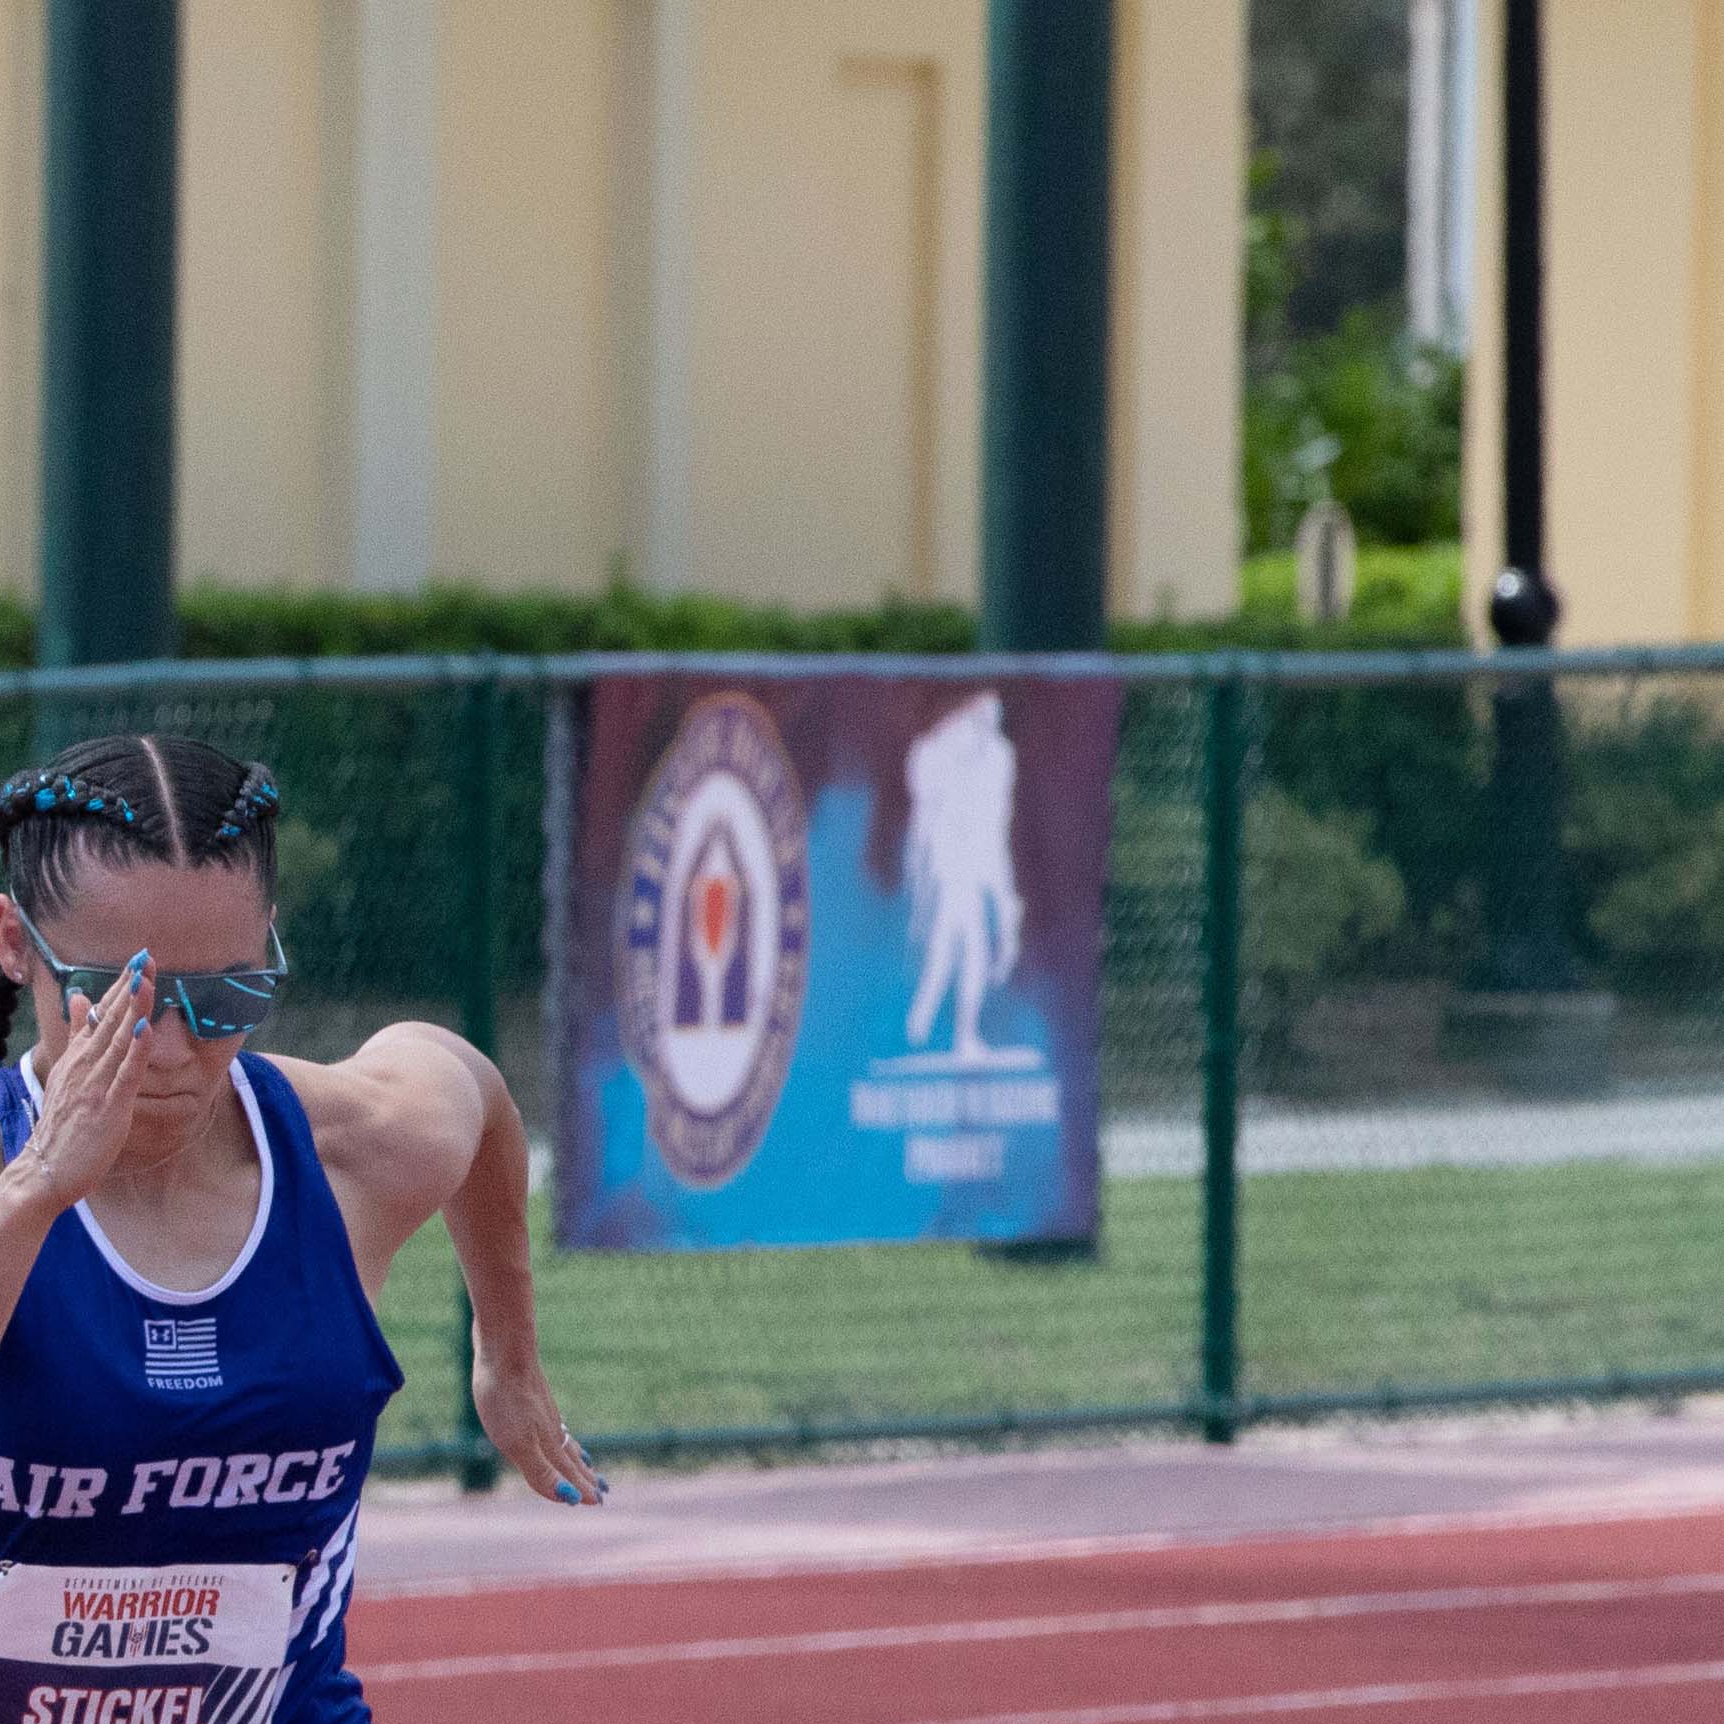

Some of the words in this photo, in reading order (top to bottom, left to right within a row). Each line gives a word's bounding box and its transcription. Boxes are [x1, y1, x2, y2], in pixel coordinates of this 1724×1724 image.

[146, 1374, 224, 1391] FREEDOM
[121, 1438, 358, 1515] FORCE
[62, 1587, 221, 1618] WARRIOR
[51, 1617, 214, 1658] GAMES
